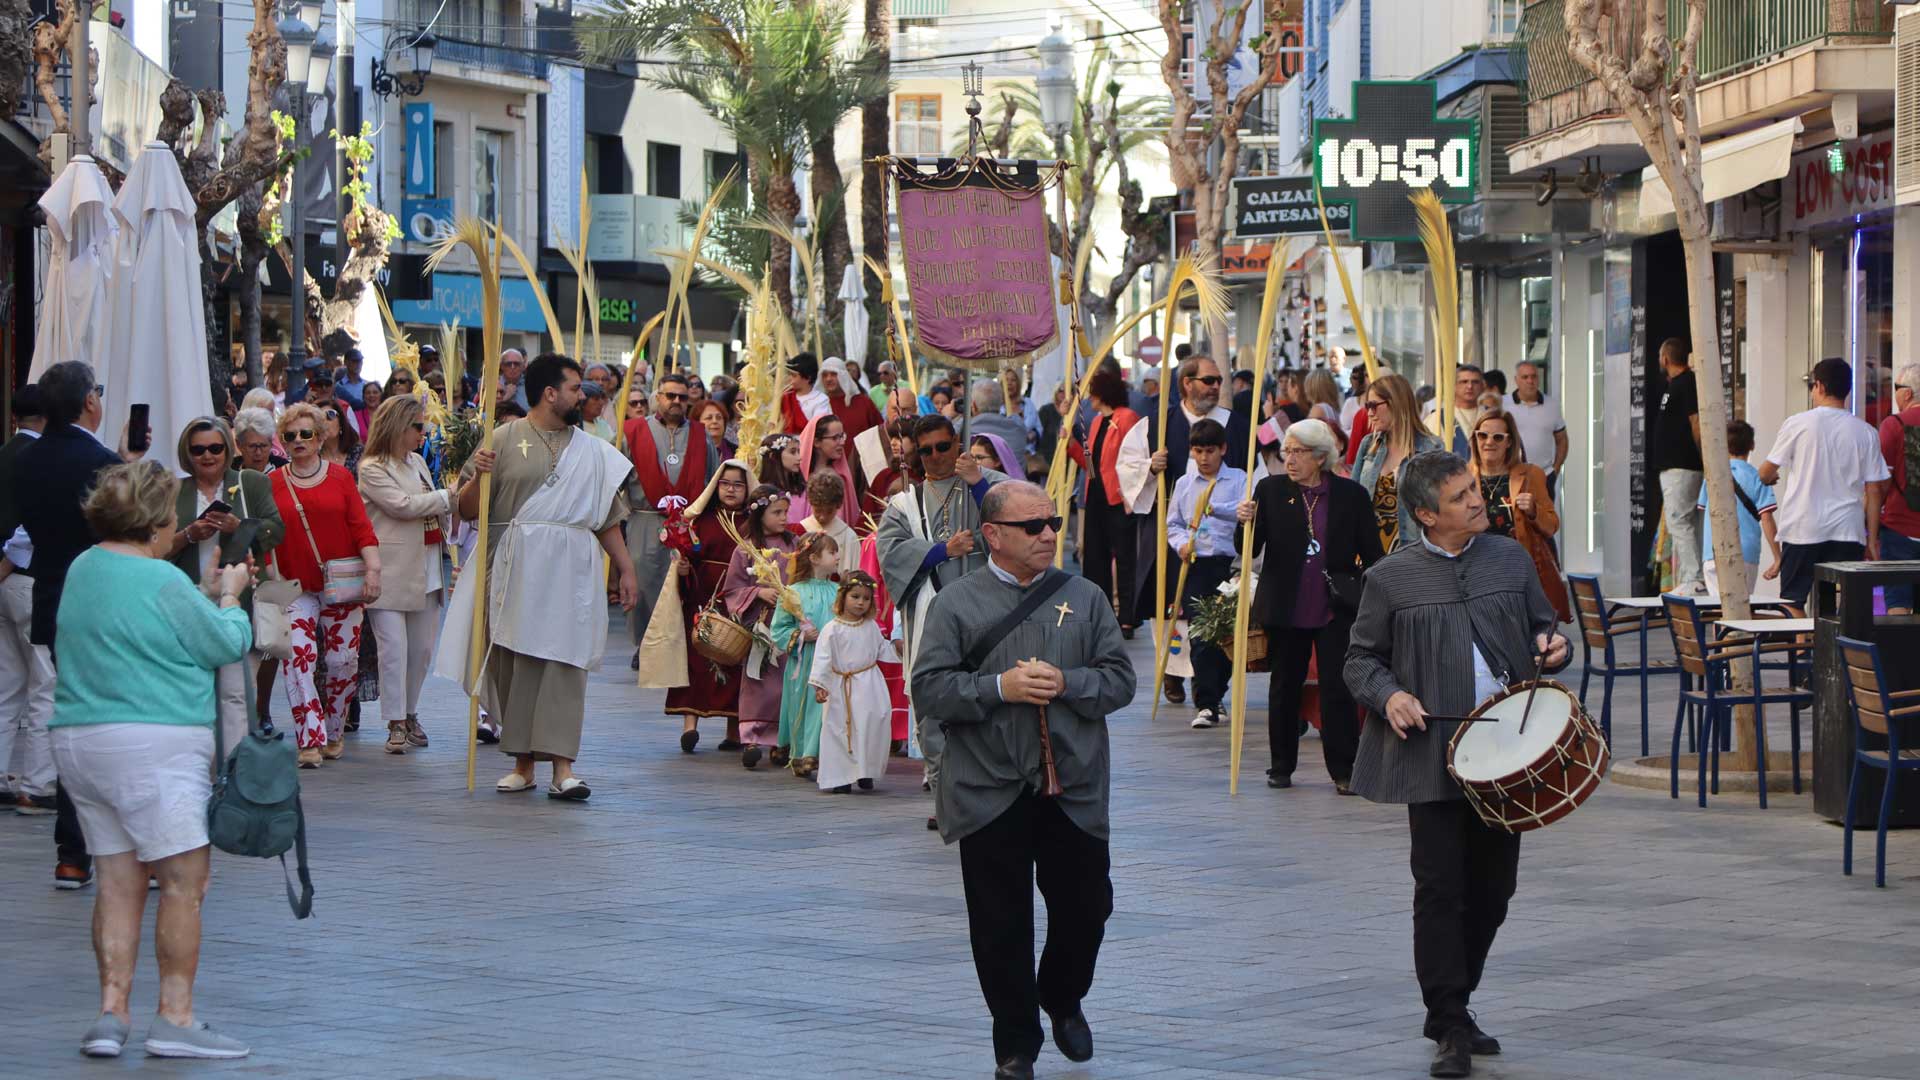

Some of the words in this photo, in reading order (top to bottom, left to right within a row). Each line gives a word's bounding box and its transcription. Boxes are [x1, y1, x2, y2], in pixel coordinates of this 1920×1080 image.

[1319, 138, 1470, 187] 10:50
[1796, 158, 1834, 219] LOW
[1842, 141, 1892, 204] COST
[1243, 205, 1349, 225] ARTESANOS
